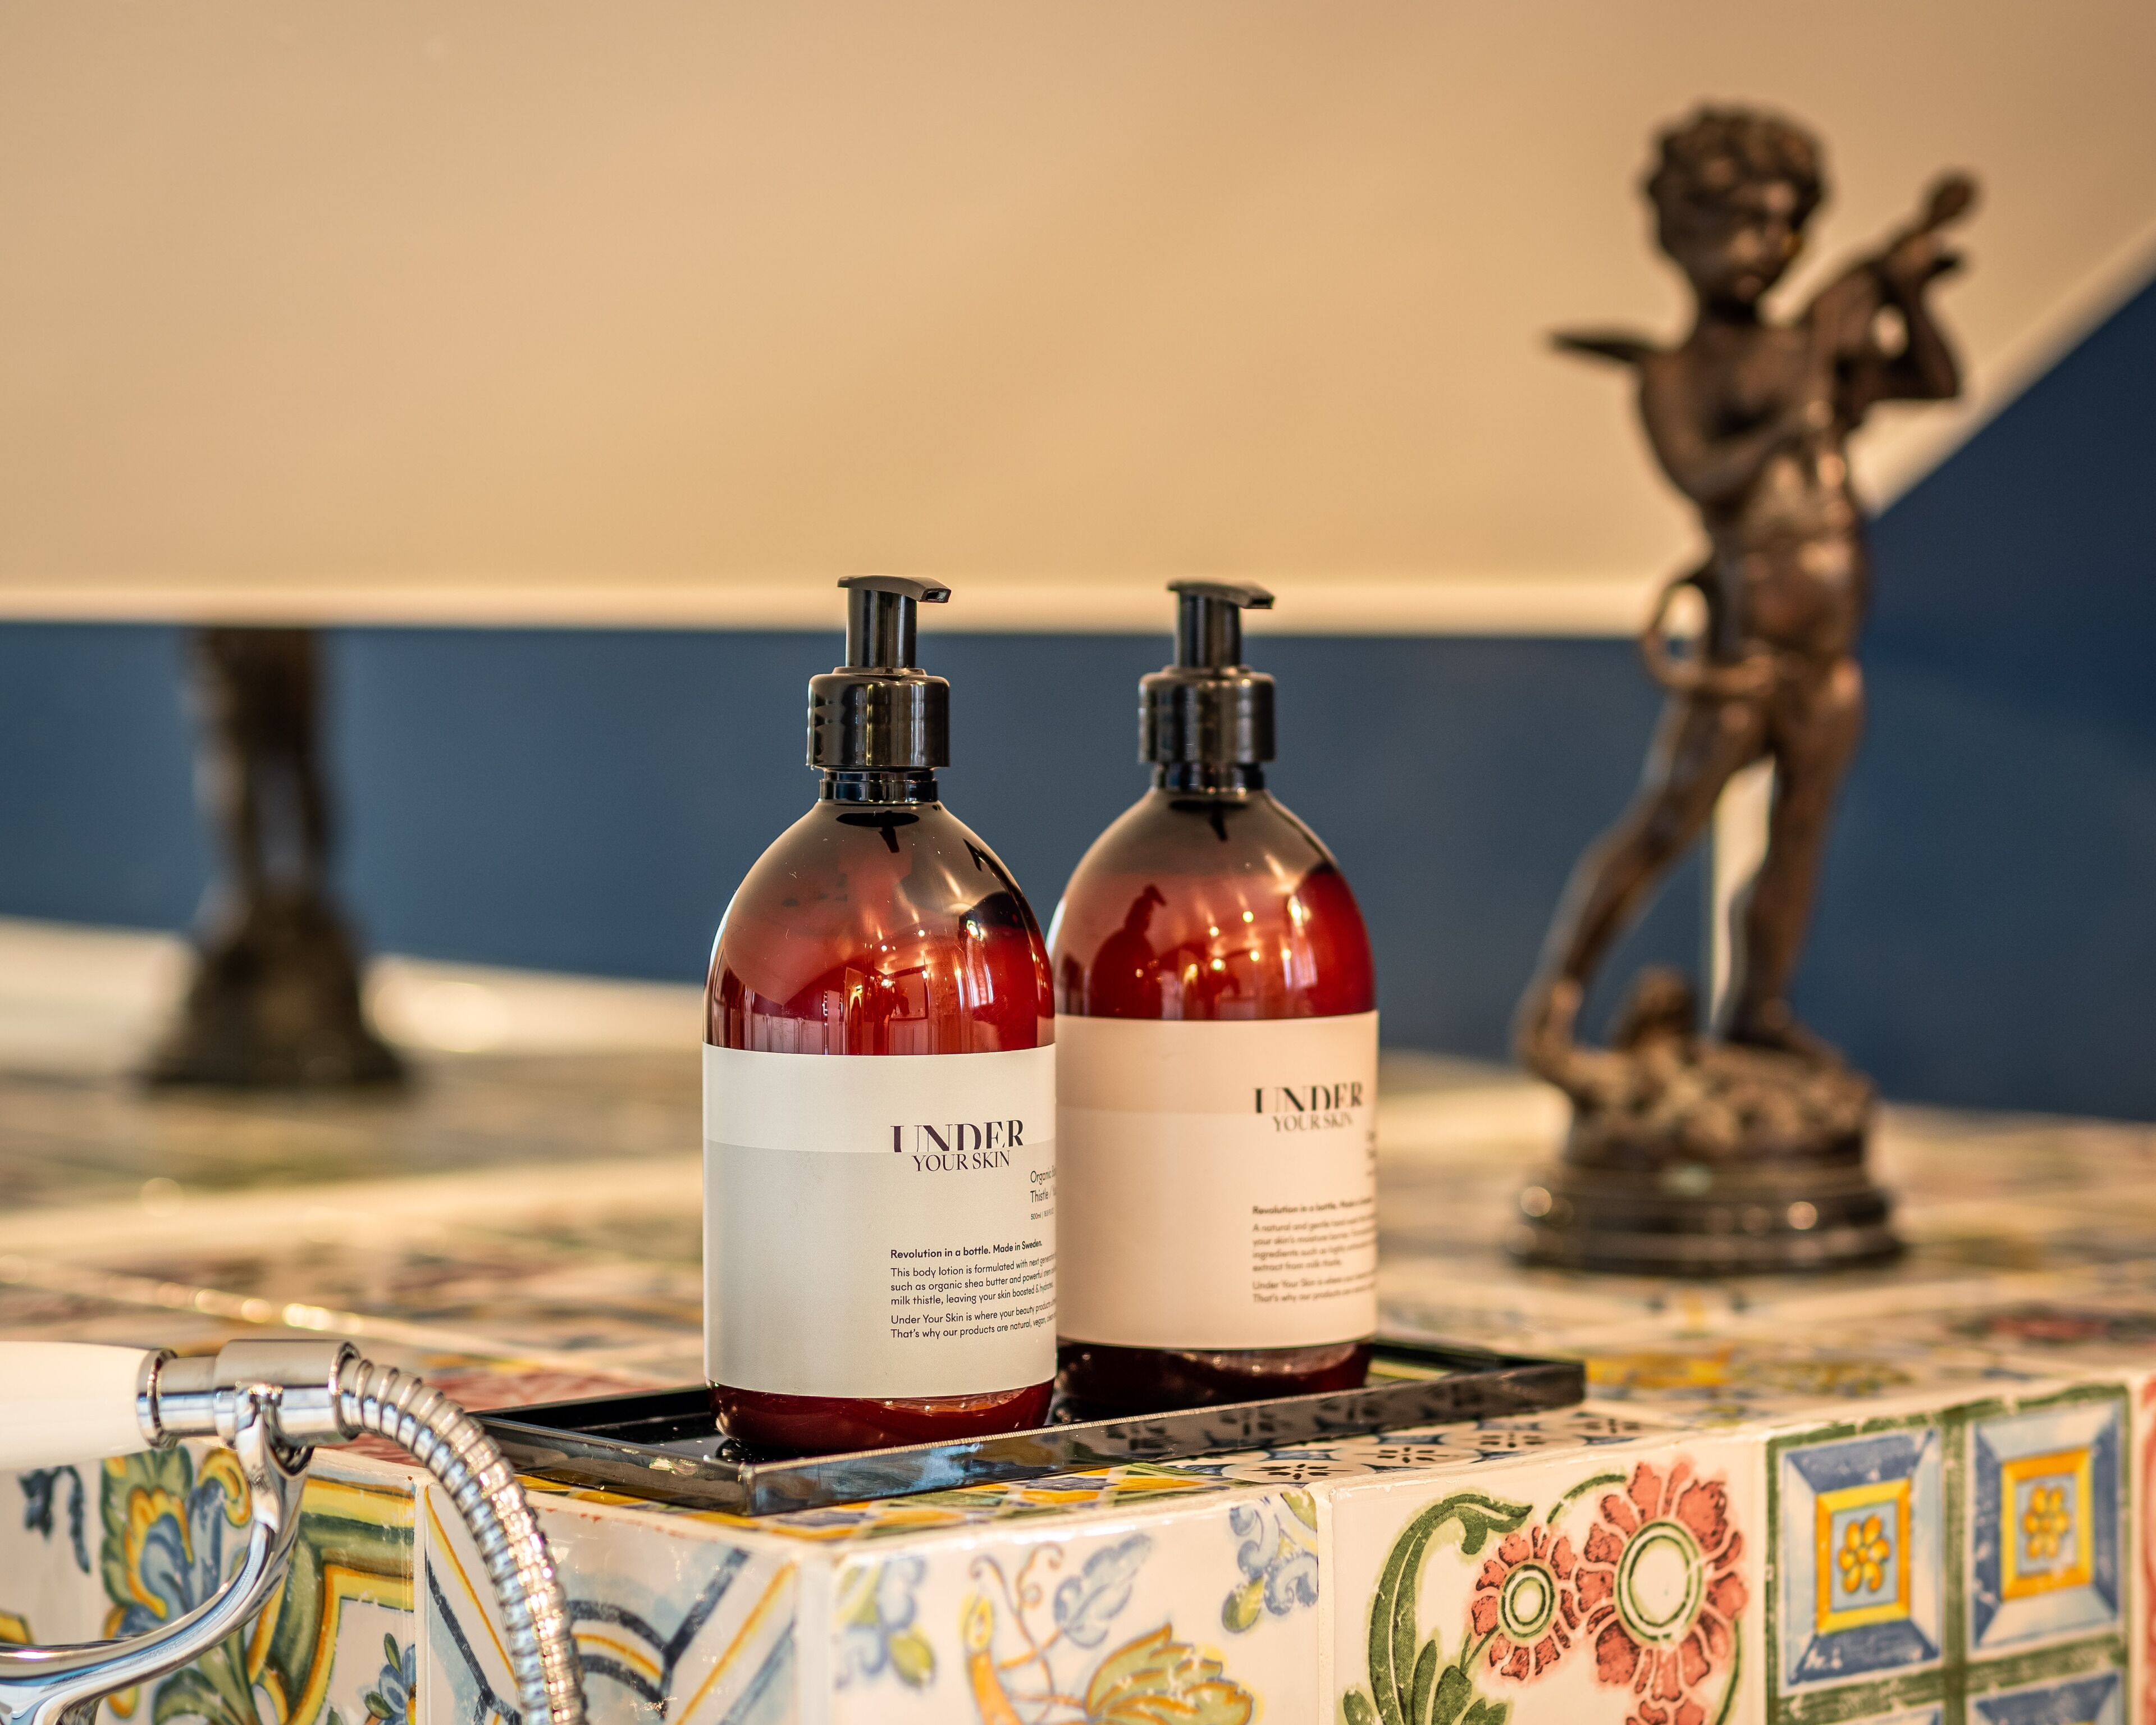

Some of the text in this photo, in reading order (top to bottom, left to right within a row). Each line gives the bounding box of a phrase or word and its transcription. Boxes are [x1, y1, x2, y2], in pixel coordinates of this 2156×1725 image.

[1253, 1081, 1362, 1114] UNDER
[1273, 1111, 1353, 1132] YOUR SKIN
[890, 1119, 1024, 1153] UNDER
[911, 1150, 1010, 1172] YOUR SKIN
[1030, 1167, 1051, 1185] Organic
[1030, 1187, 1048, 1203] Thistle
[1253, 1206, 1298, 1215] Revolution
[891, 1249, 942, 1258] Revolution
[945, 1248, 953, 1257] in
[963, 1245, 990, 1256] bottle.
[993, 1243, 1013, 1253] Made
[1022, 1239, 1042, 1249] Sweden.
[1253, 1238, 1271, 1247] your
[1253, 1249, 1299, 1260] ingredients
[891, 1267, 910, 1277] This
[913, 1267, 936, 1278] body
[939, 1266, 963, 1276] lotion
[966, 1265, 972, 1274] is
[975, 1261, 1014, 1274] formulated
[1016, 1258, 1027, 1269] with
[1029, 1258, 1039, 1266] next
[1253, 1263, 1282, 1271] extract
[1286, 1261, 1303, 1270] from
[891, 1281, 912, 1291] such
[929, 1280, 962, 1292] organic
[965, 1279, 983, 1288] shea
[986, 1277, 1008, 1286] butter
[1010, 1274, 1021, 1284] and
[1023, 1268, 1043, 1284] powerful
[1253, 1281, 1278, 1289] Under
[1282, 1280, 1298, 1288] Your
[891, 1295, 910, 1306] milk
[913, 1294, 943, 1305] thistle,
[947, 1293, 976, 1303] leaving
[979, 1294, 995, 1302] your
[998, 1290, 1010, 1299] skin
[1013, 1286, 1034, 1297] boosted
[1036, 1284, 1039, 1293] &
[1281, 1293, 1296, 1302] why
[891, 1315, 920, 1324] Under
[923, 1314, 943, 1324] Your
[946, 1313, 963, 1322] Skin
[966, 1312, 972, 1321] is
[975, 1311, 997, 1320] where
[1000, 1309, 1014, 1319] your
[1016, 1305, 1034, 1316] beauty
[922, 1328, 940, 1339] why
[960, 1325, 995, 1338] products
[1011, 1320, 1032, 1330] natural,
